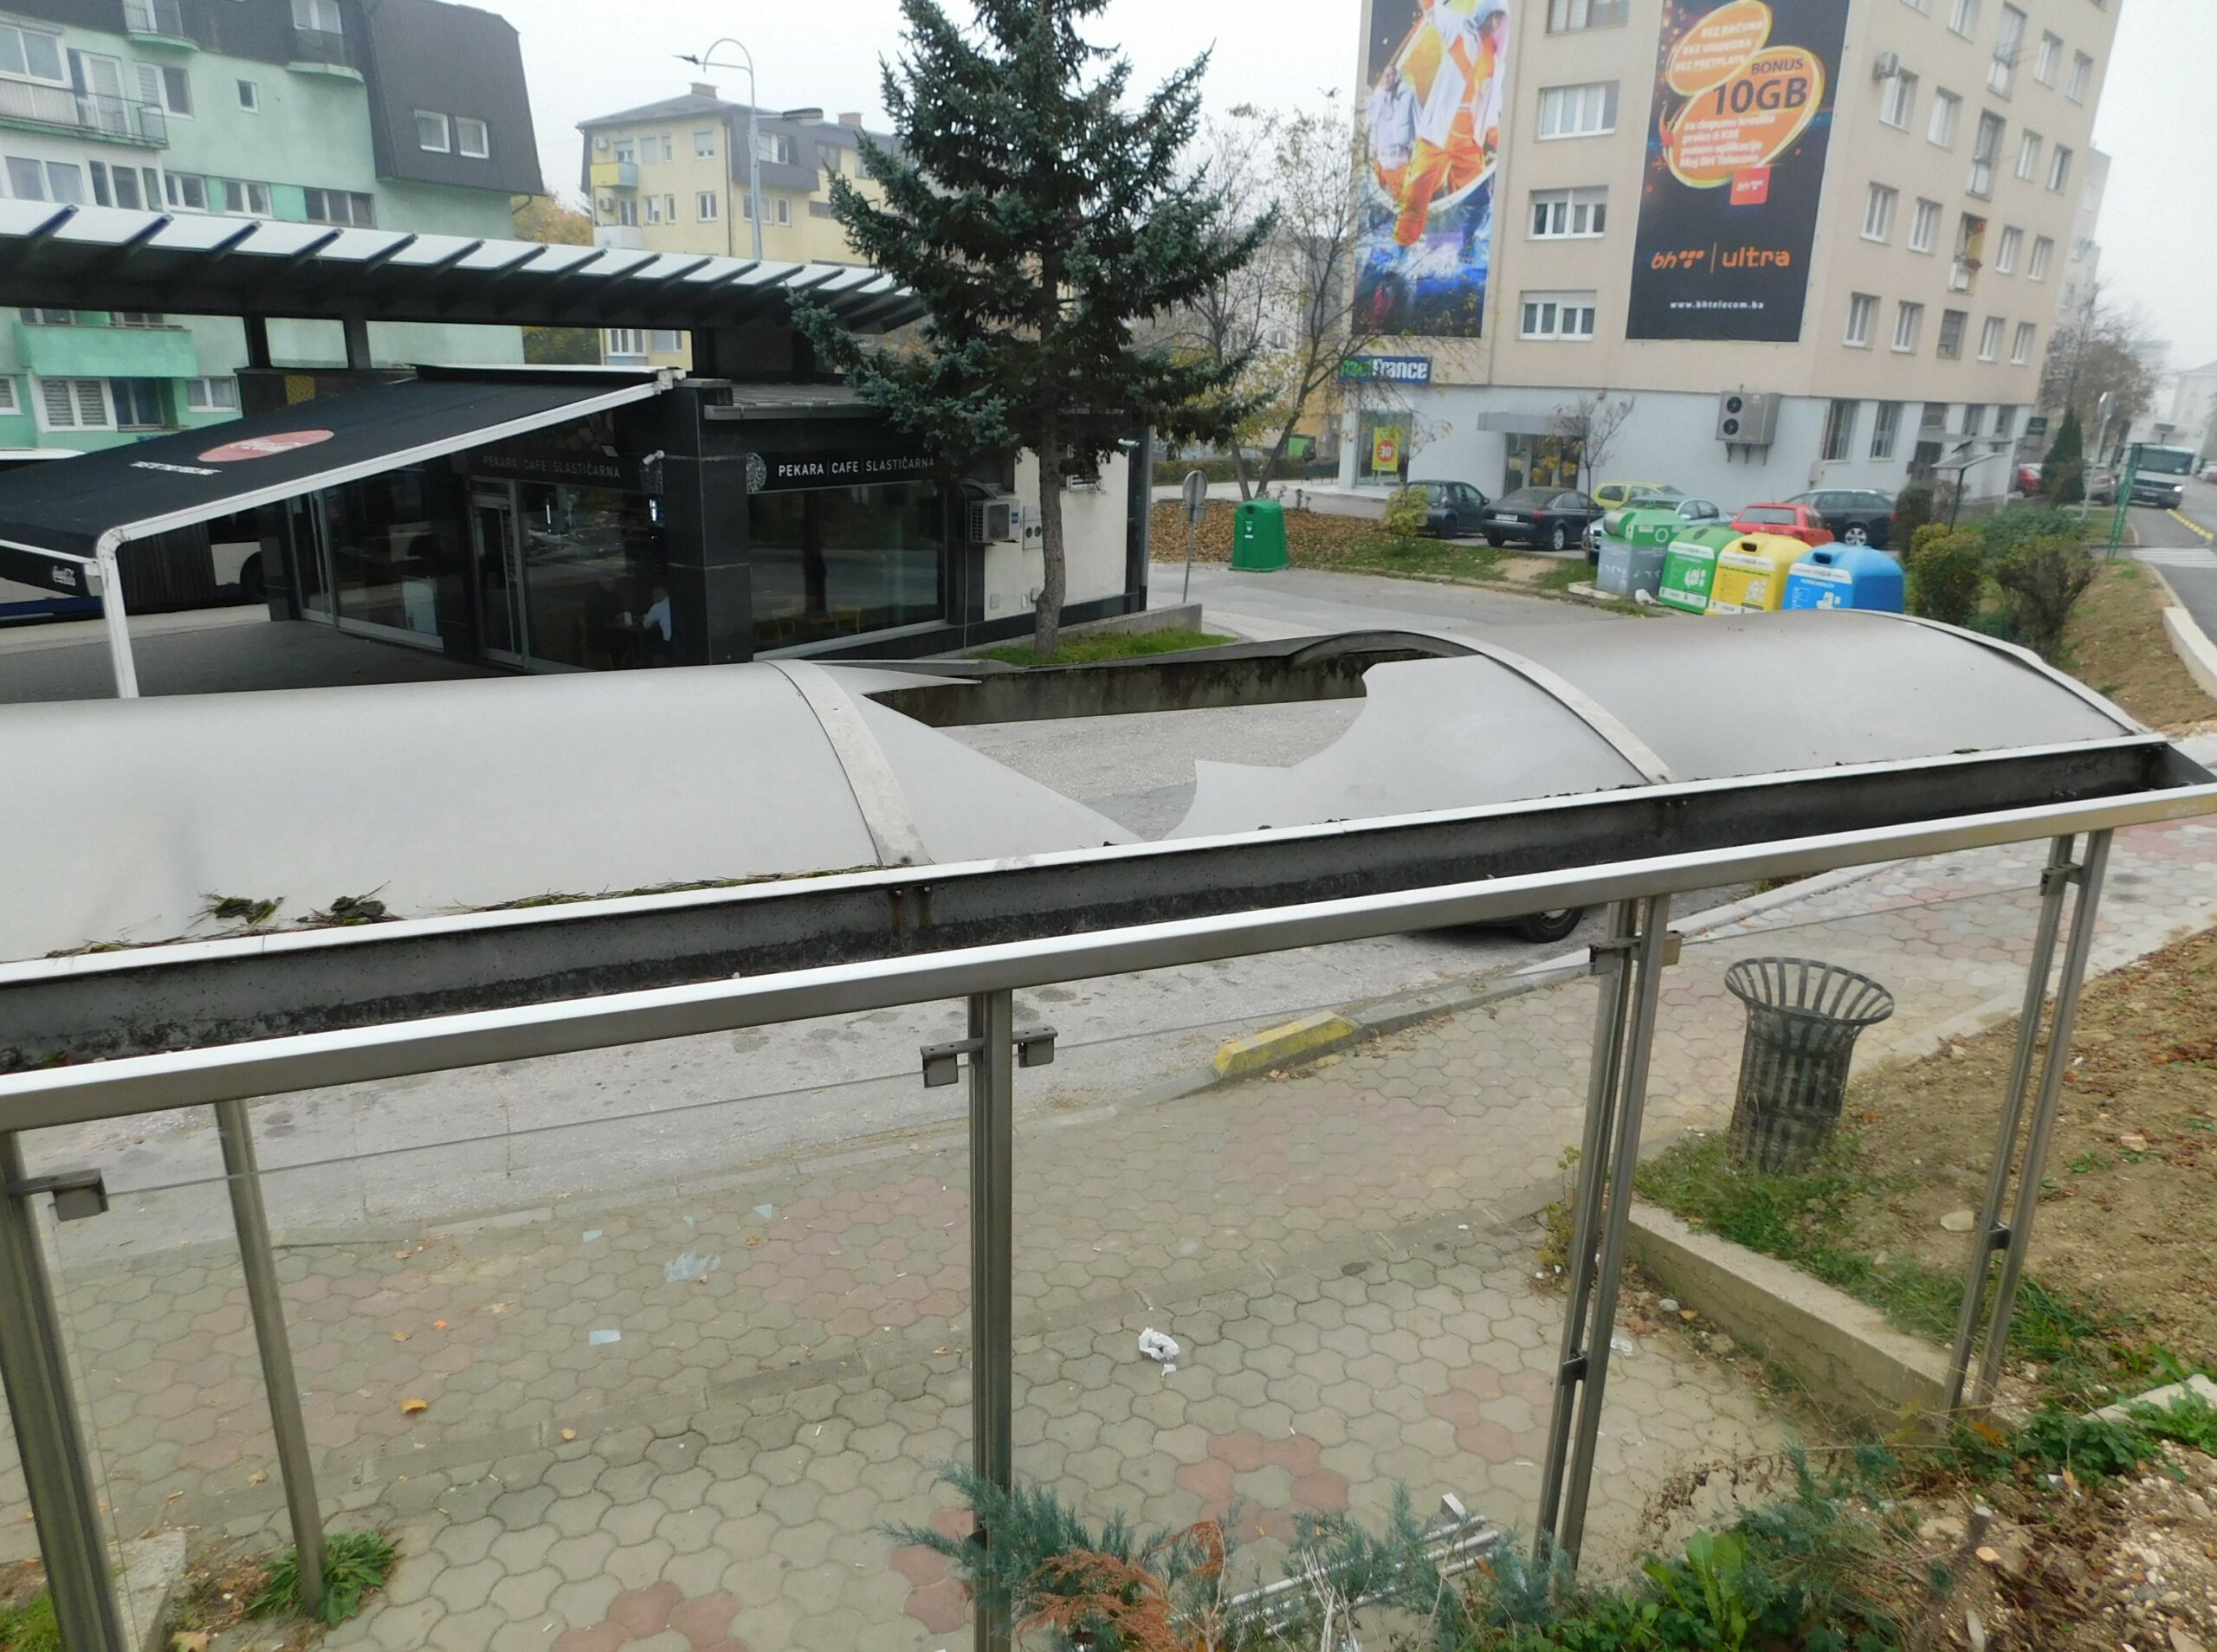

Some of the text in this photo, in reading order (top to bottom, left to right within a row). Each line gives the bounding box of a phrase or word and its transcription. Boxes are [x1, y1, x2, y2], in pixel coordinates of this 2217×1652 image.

[1751, 58, 1803, 74] BONUS
[1713, 77, 1808, 115] 10GB
[1722, 246, 1791, 268] ultra
[1670, 300, 1764, 309] www.bhtelecom.ba
[483, 455, 621, 478] PEKARA CAFE SLASTIČARNA
[779, 456, 934, 477] PEKARA CAFE SLASTIČARNA
